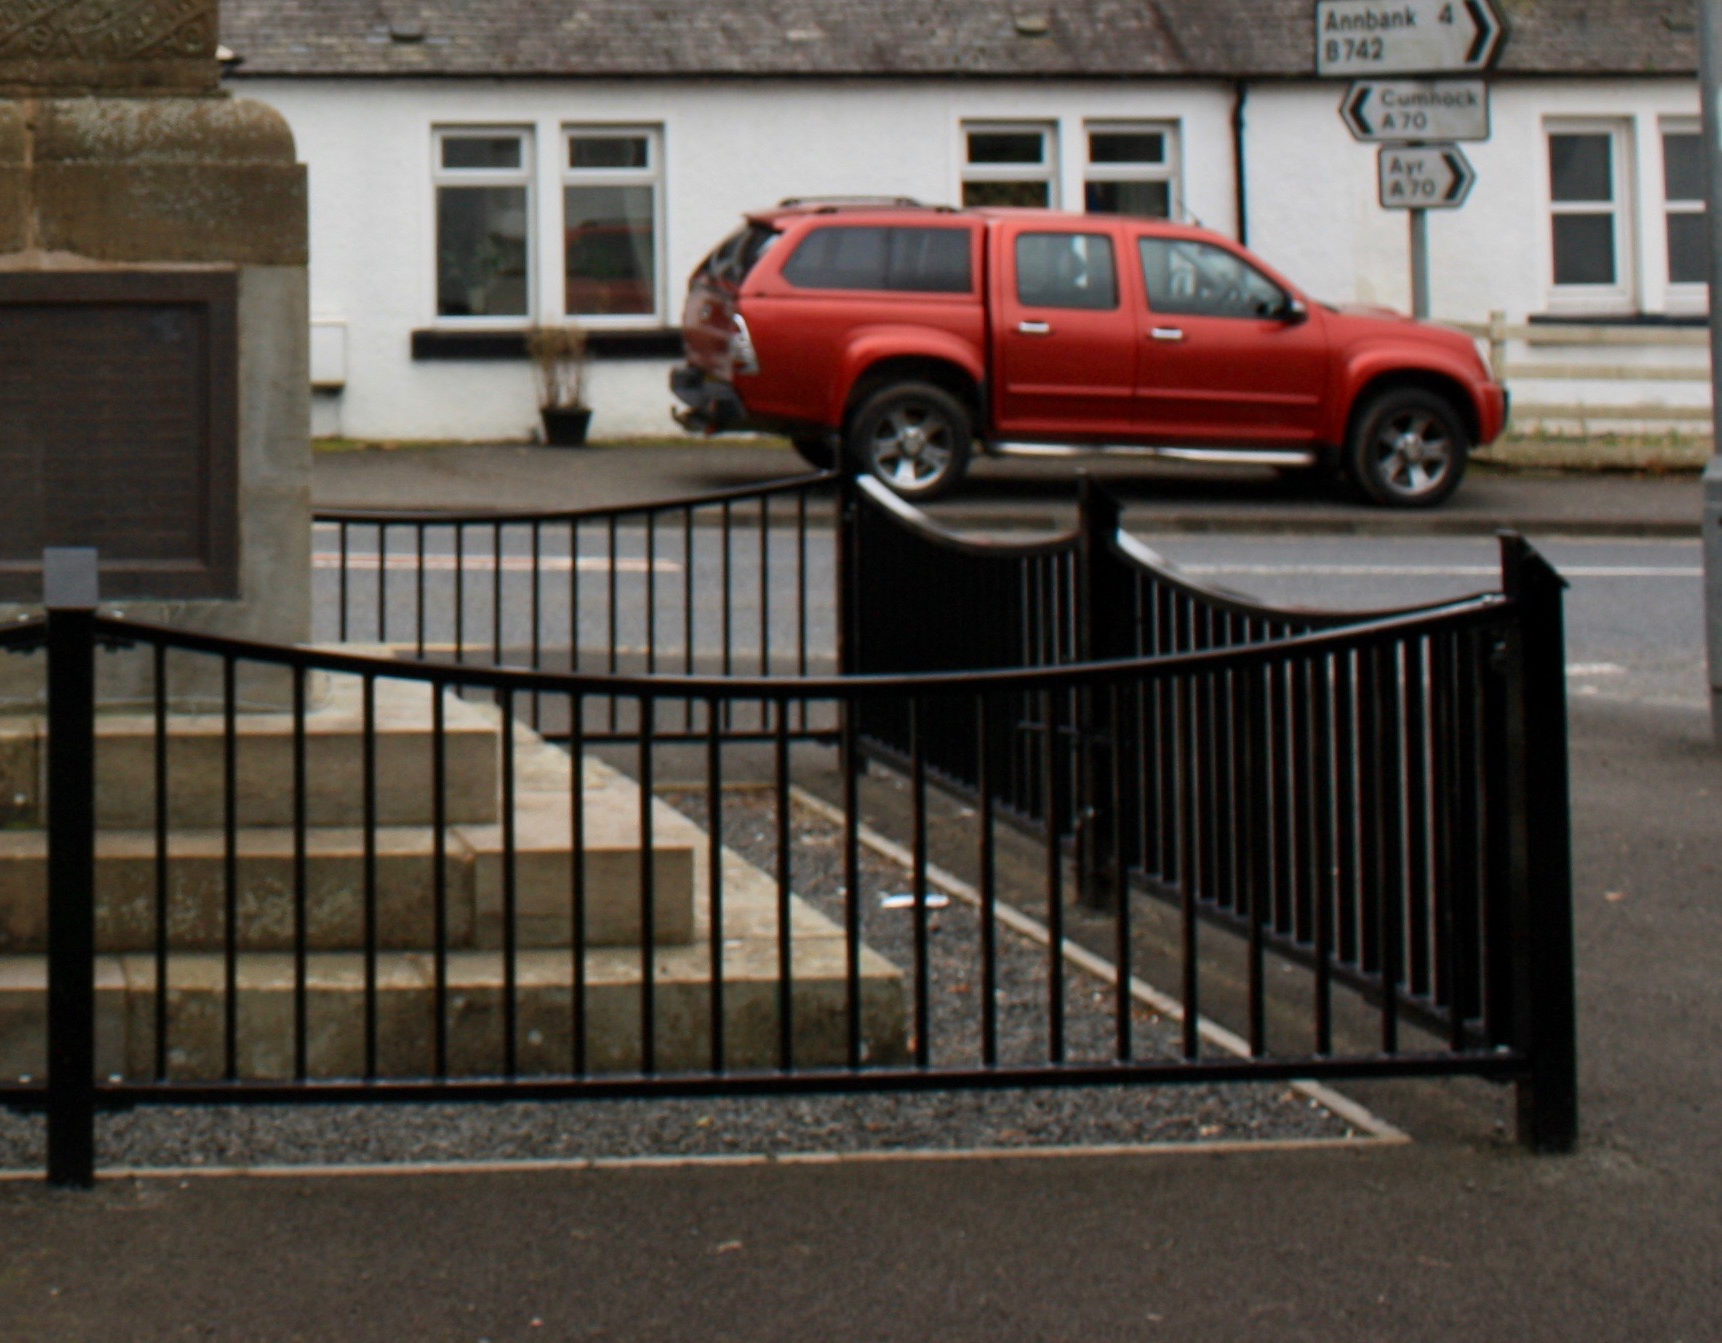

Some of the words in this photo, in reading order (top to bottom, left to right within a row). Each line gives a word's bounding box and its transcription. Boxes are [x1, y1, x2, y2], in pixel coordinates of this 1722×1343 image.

[1326, 7, 1415, 30] Annbank
[1438, 3, 1452, 24] 4
[1389, 156, 1424, 177] Ayr
